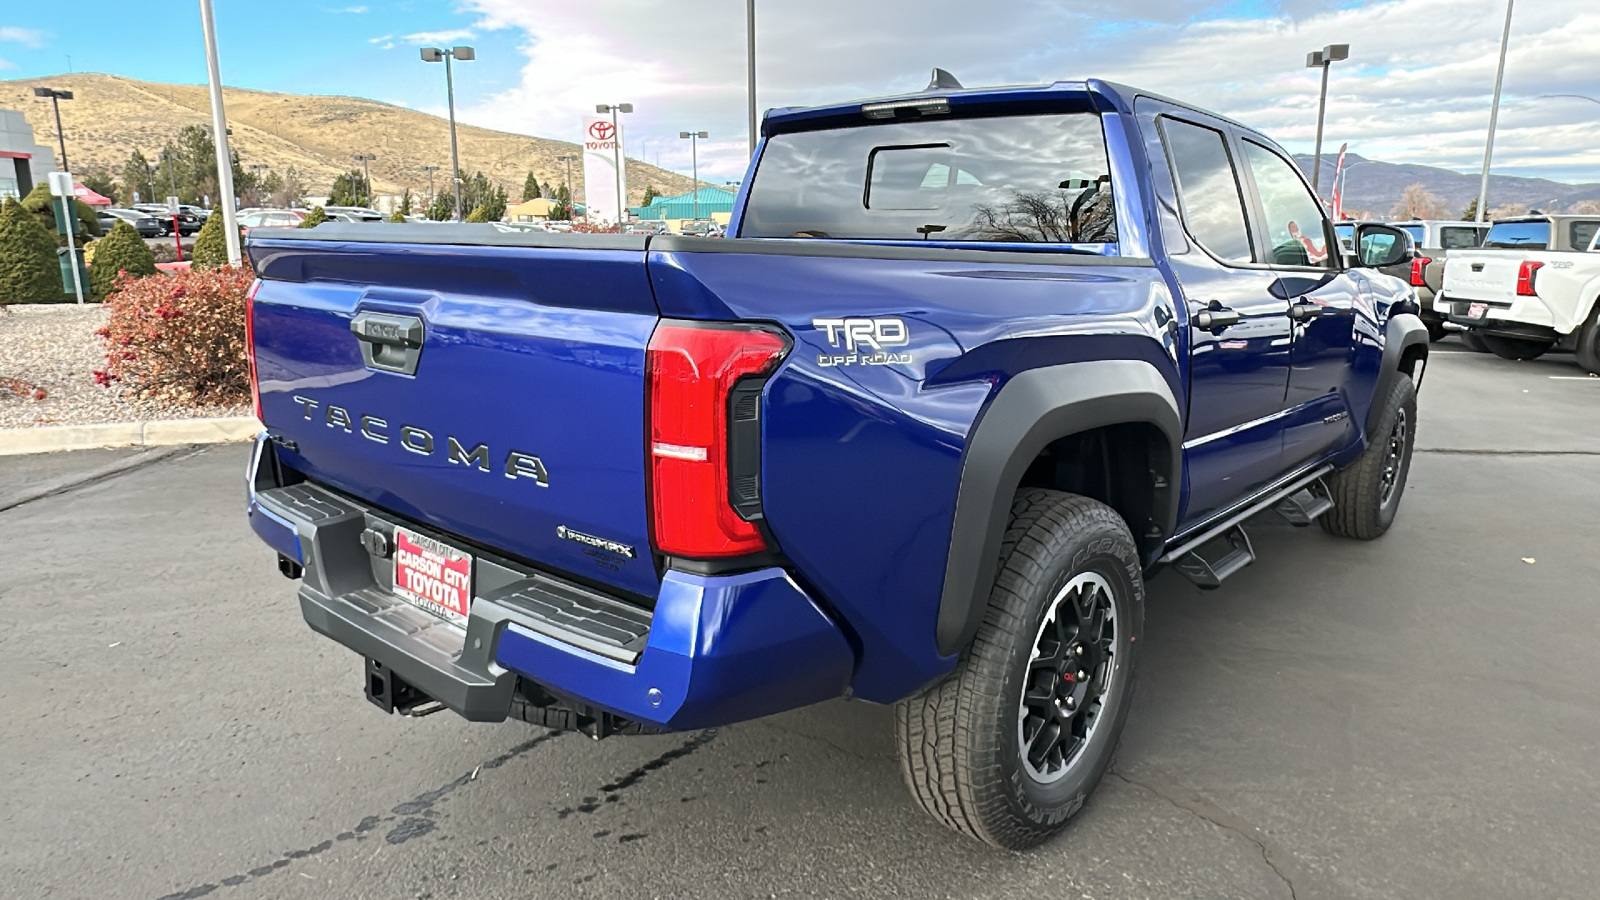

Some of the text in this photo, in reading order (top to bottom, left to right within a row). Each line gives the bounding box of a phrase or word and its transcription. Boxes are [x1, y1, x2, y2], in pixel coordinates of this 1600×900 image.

[812, 318, 909, 353] TRD
[817, 353, 912, 366] OFF ROAD
[293, 395, 549, 487] TACOMA
[412, 534, 453, 558] CARSON CITY
[398, 549, 469, 590] CARSON CITY
[405, 567, 461, 611] TOYOTA
[413, 593, 448, 617] TOYOTA
